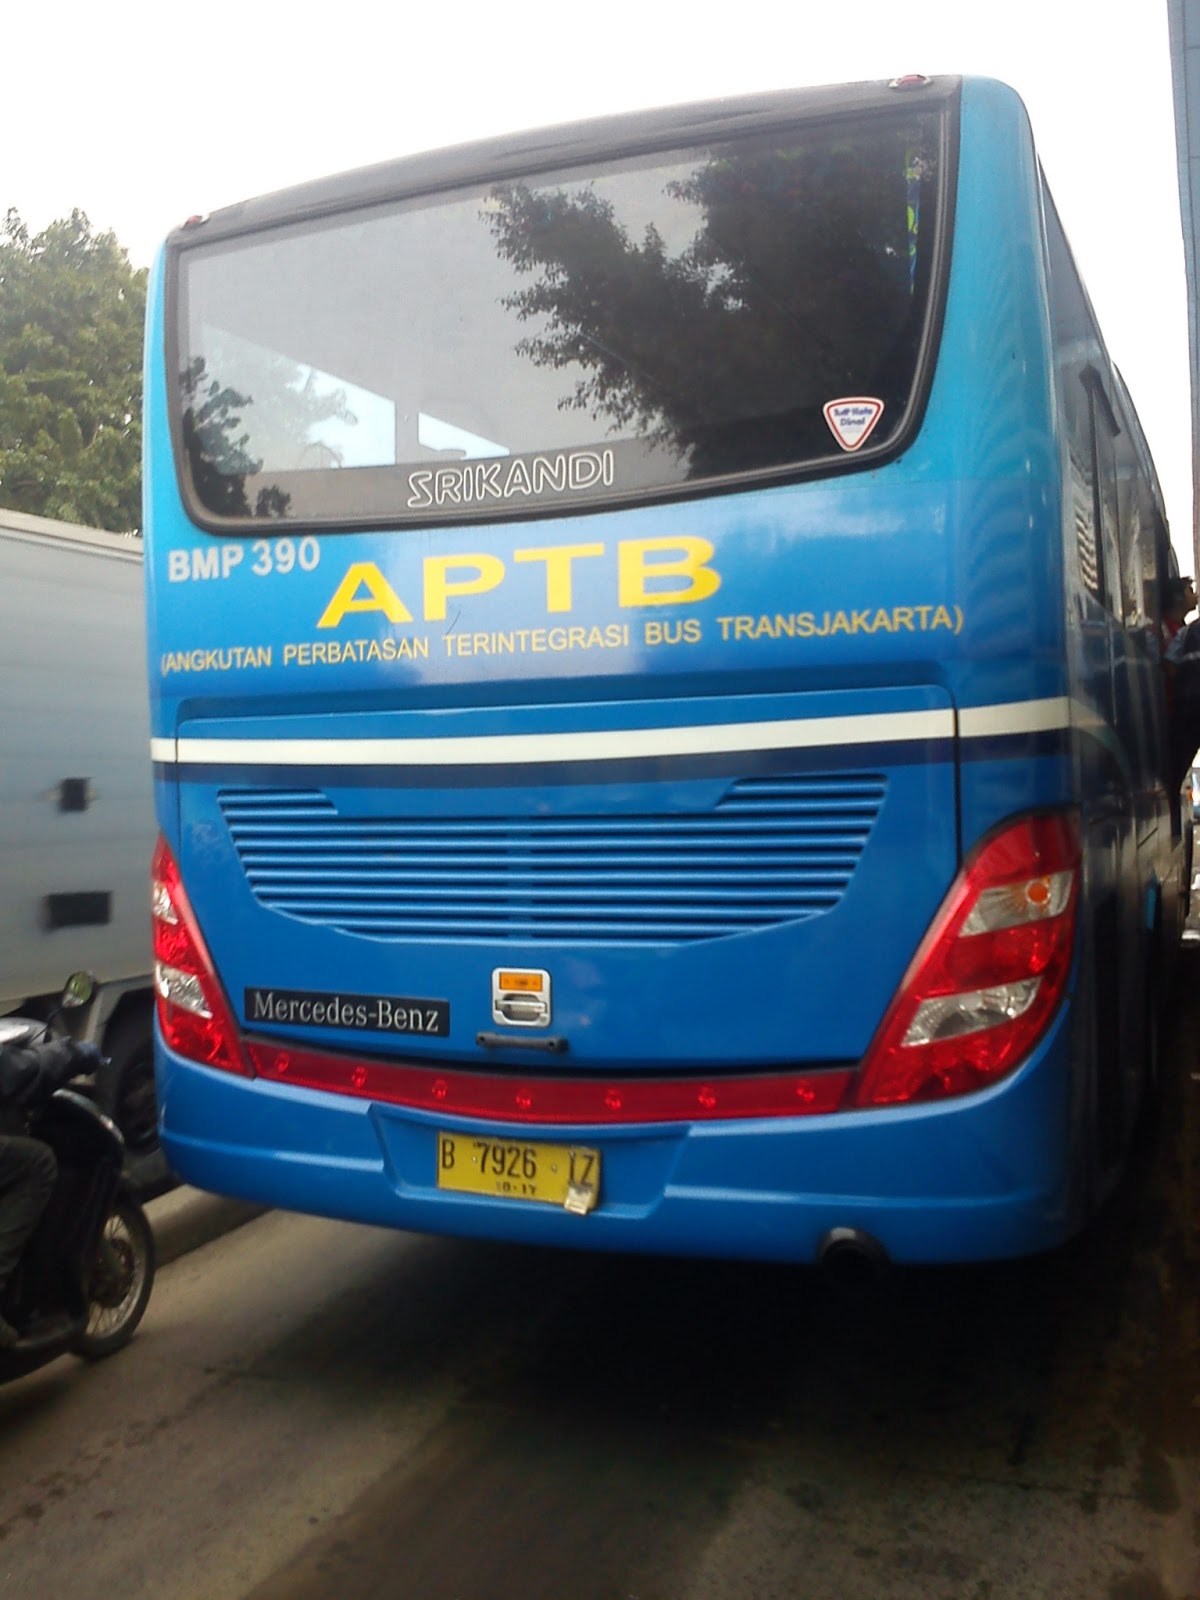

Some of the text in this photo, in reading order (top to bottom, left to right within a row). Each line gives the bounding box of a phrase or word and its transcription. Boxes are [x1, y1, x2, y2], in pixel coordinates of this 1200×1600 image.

[407, 449, 615, 509] SRIKANDI
[168, 536, 321, 582] BMP 390
[317, 536, 722, 629] APTB
[161, 605, 964, 677] (ANGKUTAN PERBATASAN TERINTEGRASI BUS TRANSJAKARTA)
[253, 991, 440, 1033] Mercedes-Benz
[441, 1138, 455, 1169] B
[474, 1141, 537, 1179] 7926
